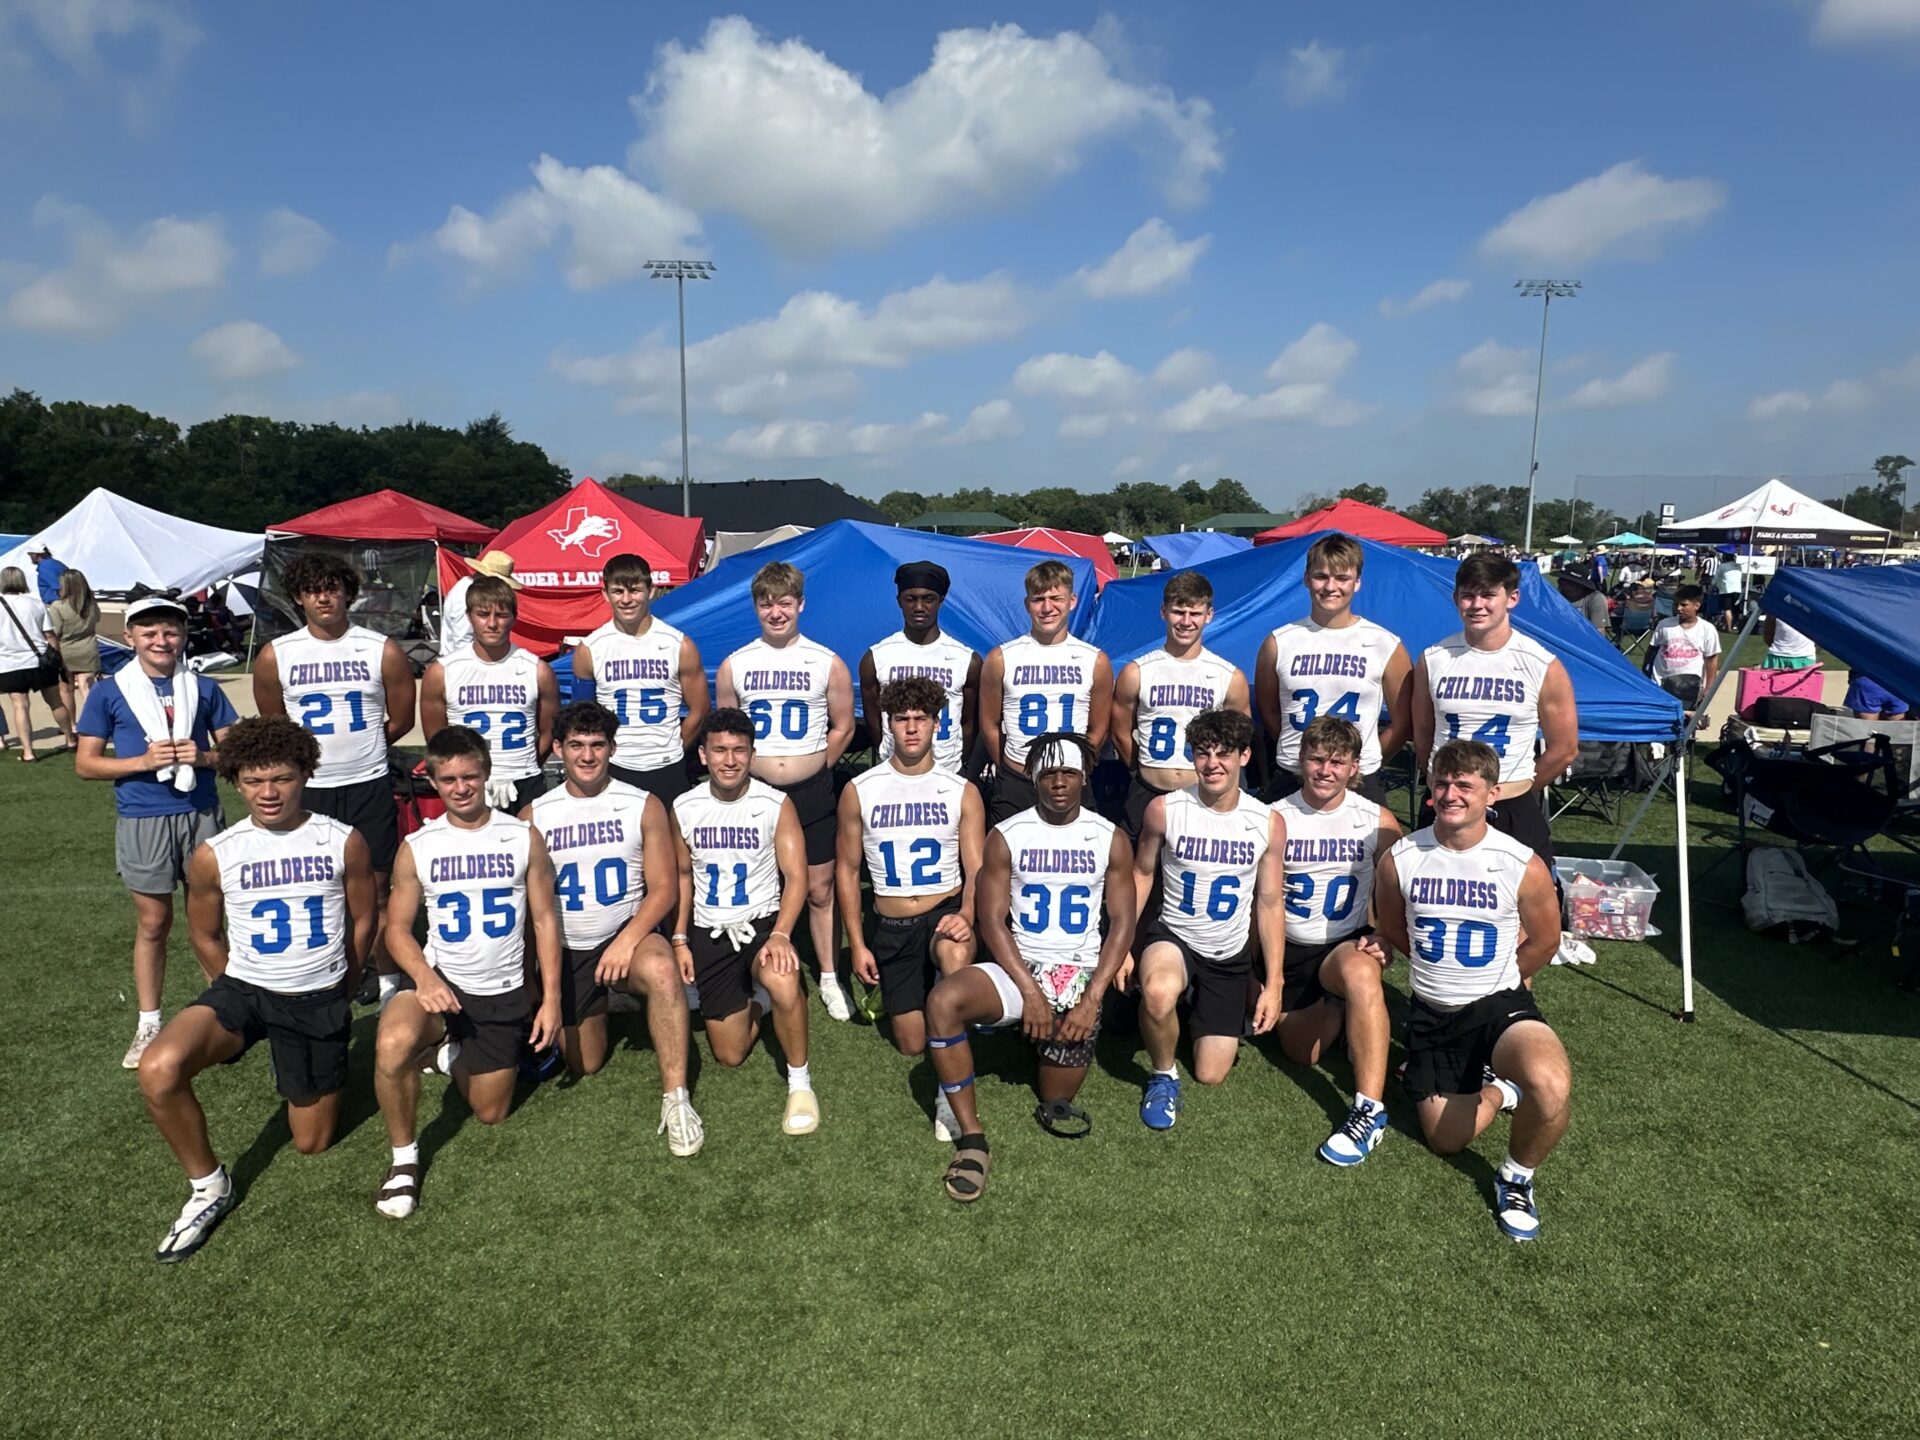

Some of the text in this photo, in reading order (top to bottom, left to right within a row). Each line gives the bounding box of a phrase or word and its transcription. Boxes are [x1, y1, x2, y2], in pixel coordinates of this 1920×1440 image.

[511, 571, 560, 587] NDER
[562, 570, 603, 586] LAD
[289, 661, 370, 686] CHILDRESS
[605, 659, 669, 682] CHILDRESS
[743, 670, 811, 691] CHILDRESS
[1013, 665, 1082, 686] CHILDRESS
[1290, 653, 1367, 679] CHILDRESS
[458, 685, 526, 705] CHILDRESS
[613, 688, 668, 725] 15
[1149, 684, 1215, 709] CHILDRESS
[1436, 676, 1524, 704] CHILDRESS
[299, 692, 368, 735] 21
[749, 699, 809, 740] 60
[1017, 693, 1076, 738] 81
[1289, 688, 1361, 732] 34
[463, 711, 528, 750] 22
[1148, 717, 1194, 763] 8
[1445, 713, 1512, 759] 14
[871, 802, 949, 829] CHILDRESS
[545, 818, 625, 853] CHILDRESS
[693, 827, 760, 849] CHILDRESS
[1175, 835, 1256, 866] CHILDRESS
[1284, 838, 1365, 863] CHILDRESS
[241, 856, 335, 890] CHILDRESS
[431, 853, 515, 883] CHILDRESS
[878, 837, 942, 888] 12
[1018, 849, 1096, 874] CHILDRESS
[554, 857, 628, 911] 40
[705, 862, 749, 907] 11
[1178, 870, 1241, 922] 16
[1284, 873, 1360, 921] 20
[1411, 878, 1498, 910] CHILDRESS
[250, 895, 330, 955] 31
[437, 888, 517, 943] 35
[881, 917, 912, 927] NIKE
[1019, 883, 1091, 935] 36
[1413, 916, 1499, 968] 30
